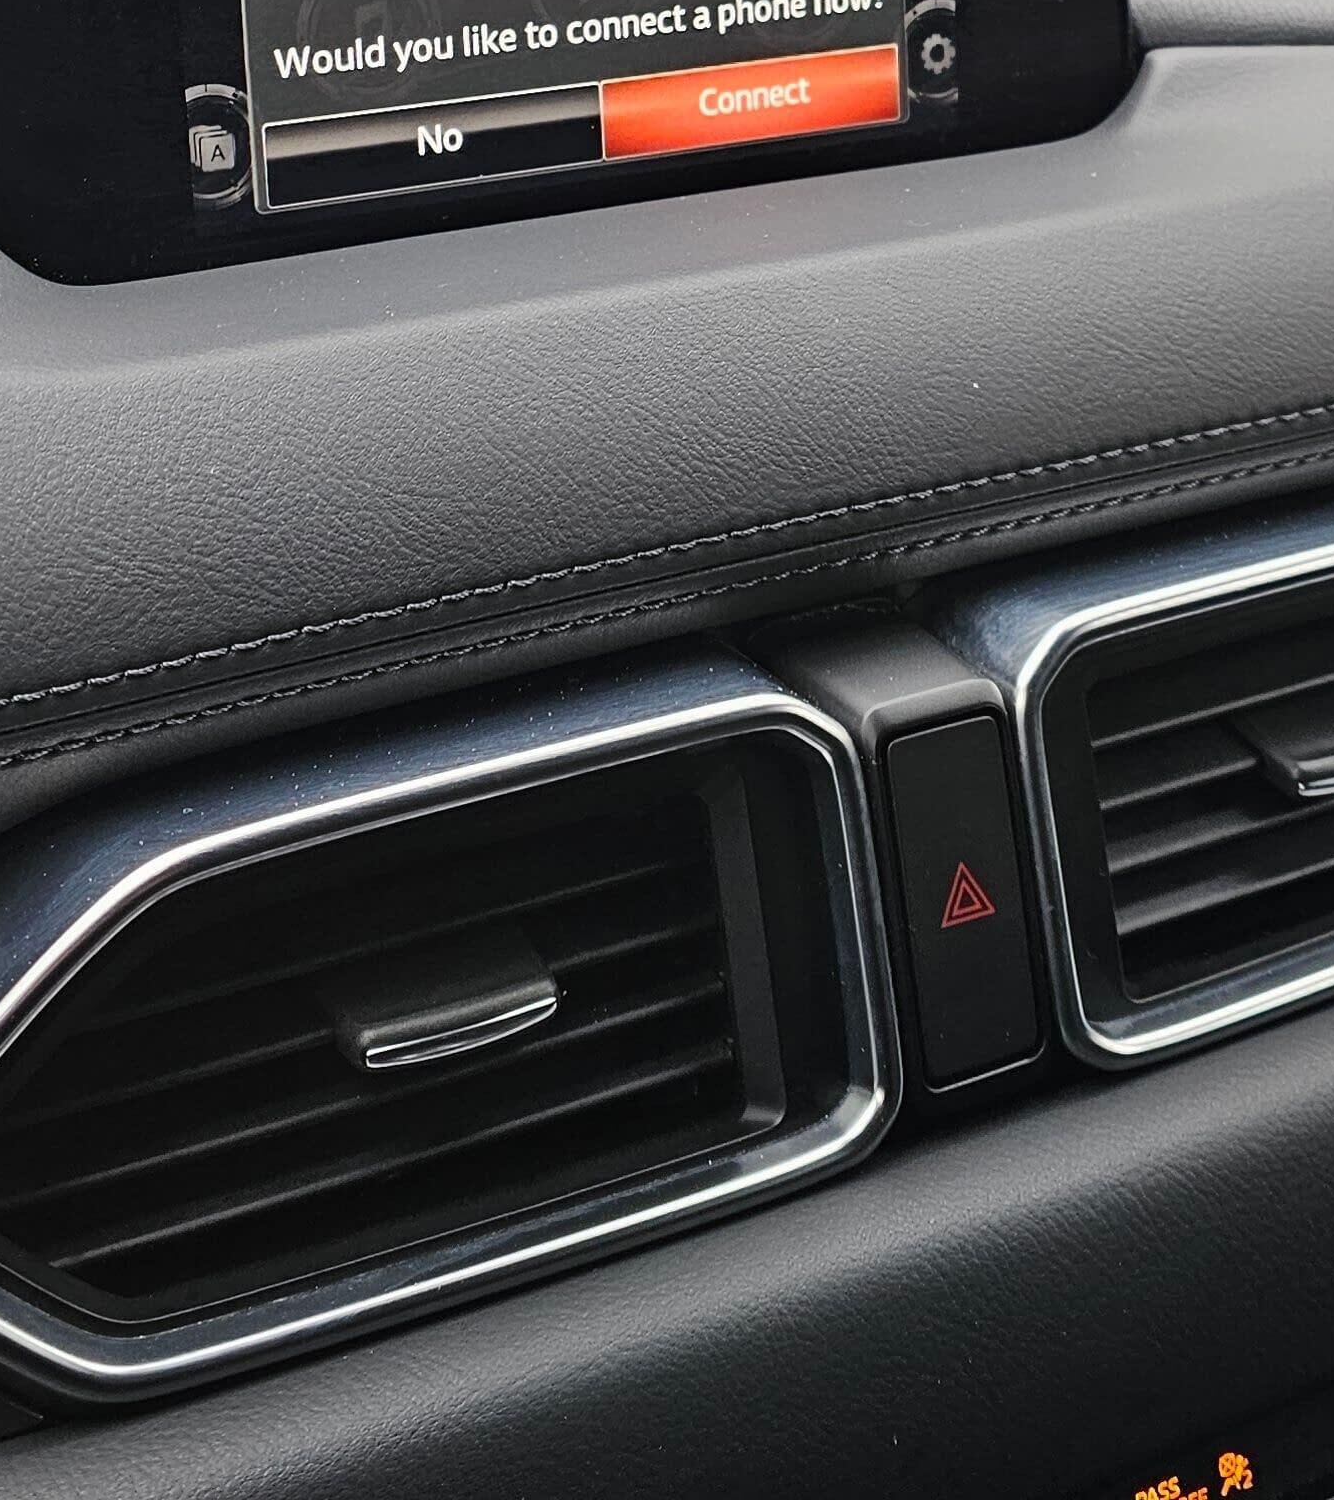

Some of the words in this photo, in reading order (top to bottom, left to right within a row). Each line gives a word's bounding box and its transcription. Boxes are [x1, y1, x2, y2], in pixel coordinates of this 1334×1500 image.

[274, 42, 387, 79] Would
[393, 36, 454, 73] you
[462, 22, 517, 57] like
[523, 20, 559, 49] to
[565, 4, 687, 45] connect
[693, 4, 712, 30] a
[698, 76, 811, 118] Connect
[416, 124, 464, 157] No
